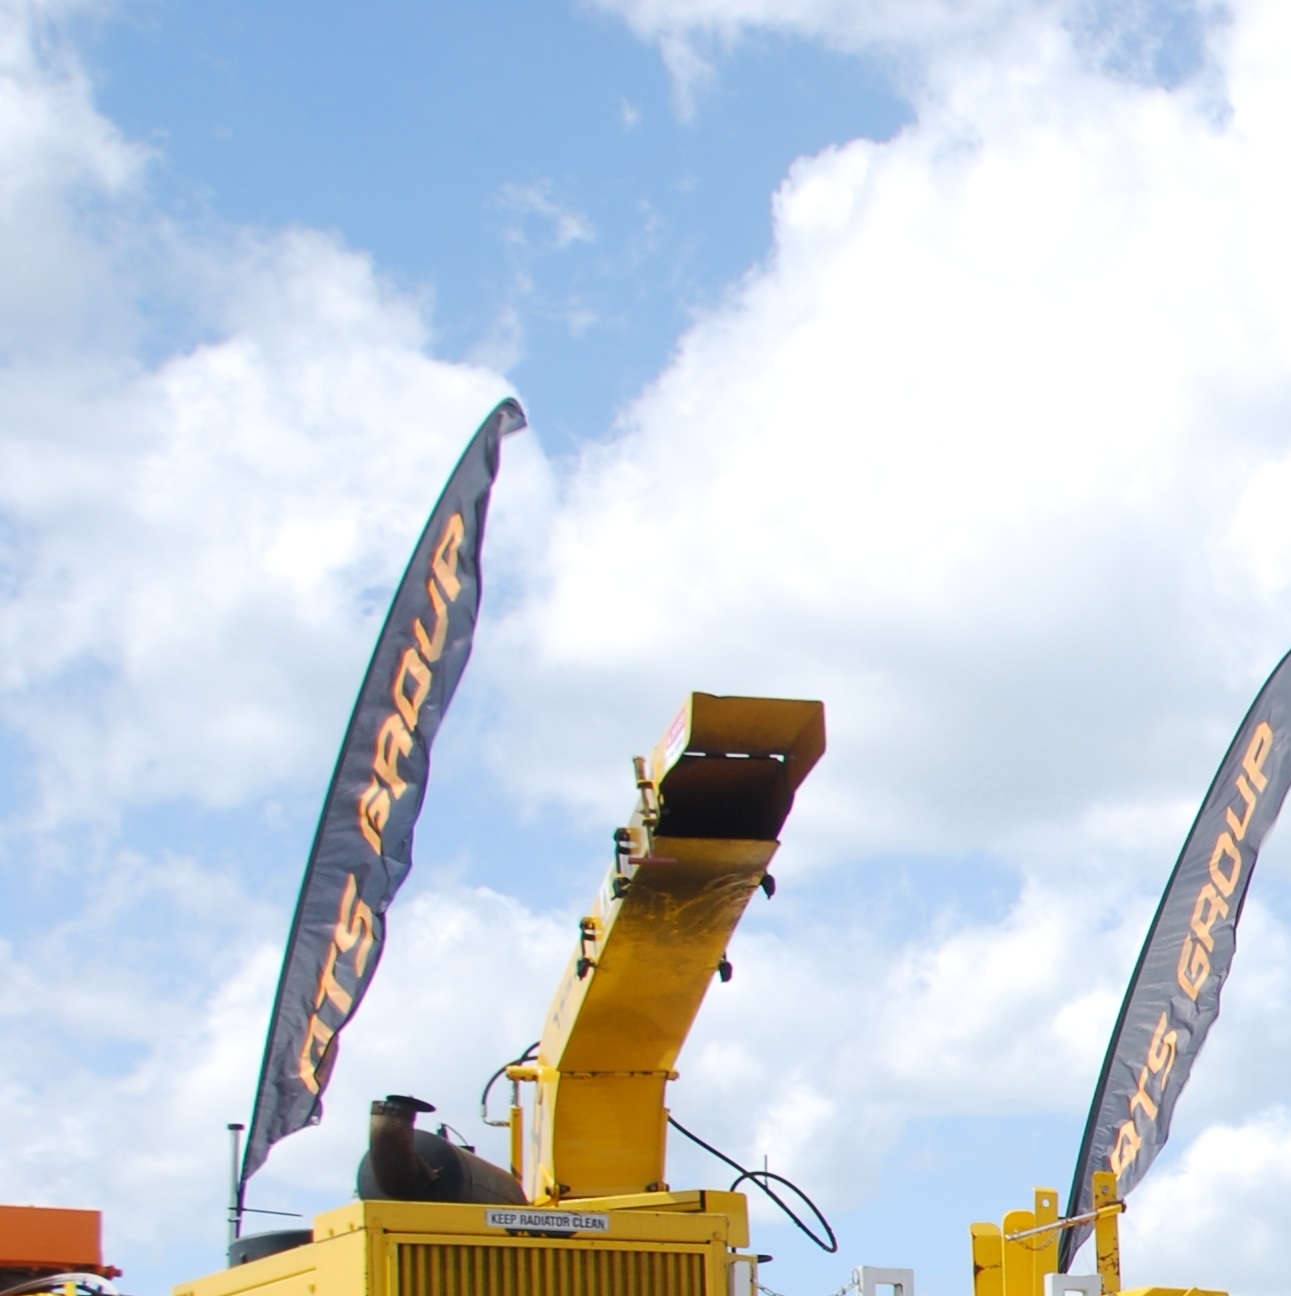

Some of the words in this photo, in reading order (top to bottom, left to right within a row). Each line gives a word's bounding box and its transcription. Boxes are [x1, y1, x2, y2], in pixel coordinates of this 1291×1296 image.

[359, 513, 466, 856] GROUP
[1111, 1011, 1178, 1180] QTS
[1177, 721, 1274, 1000] GROUP
[491, 1213, 517, 1225] KEEP
[520, 1215, 570, 1227] RADIATOR
[572, 1218, 605, 1230] CLEAN
